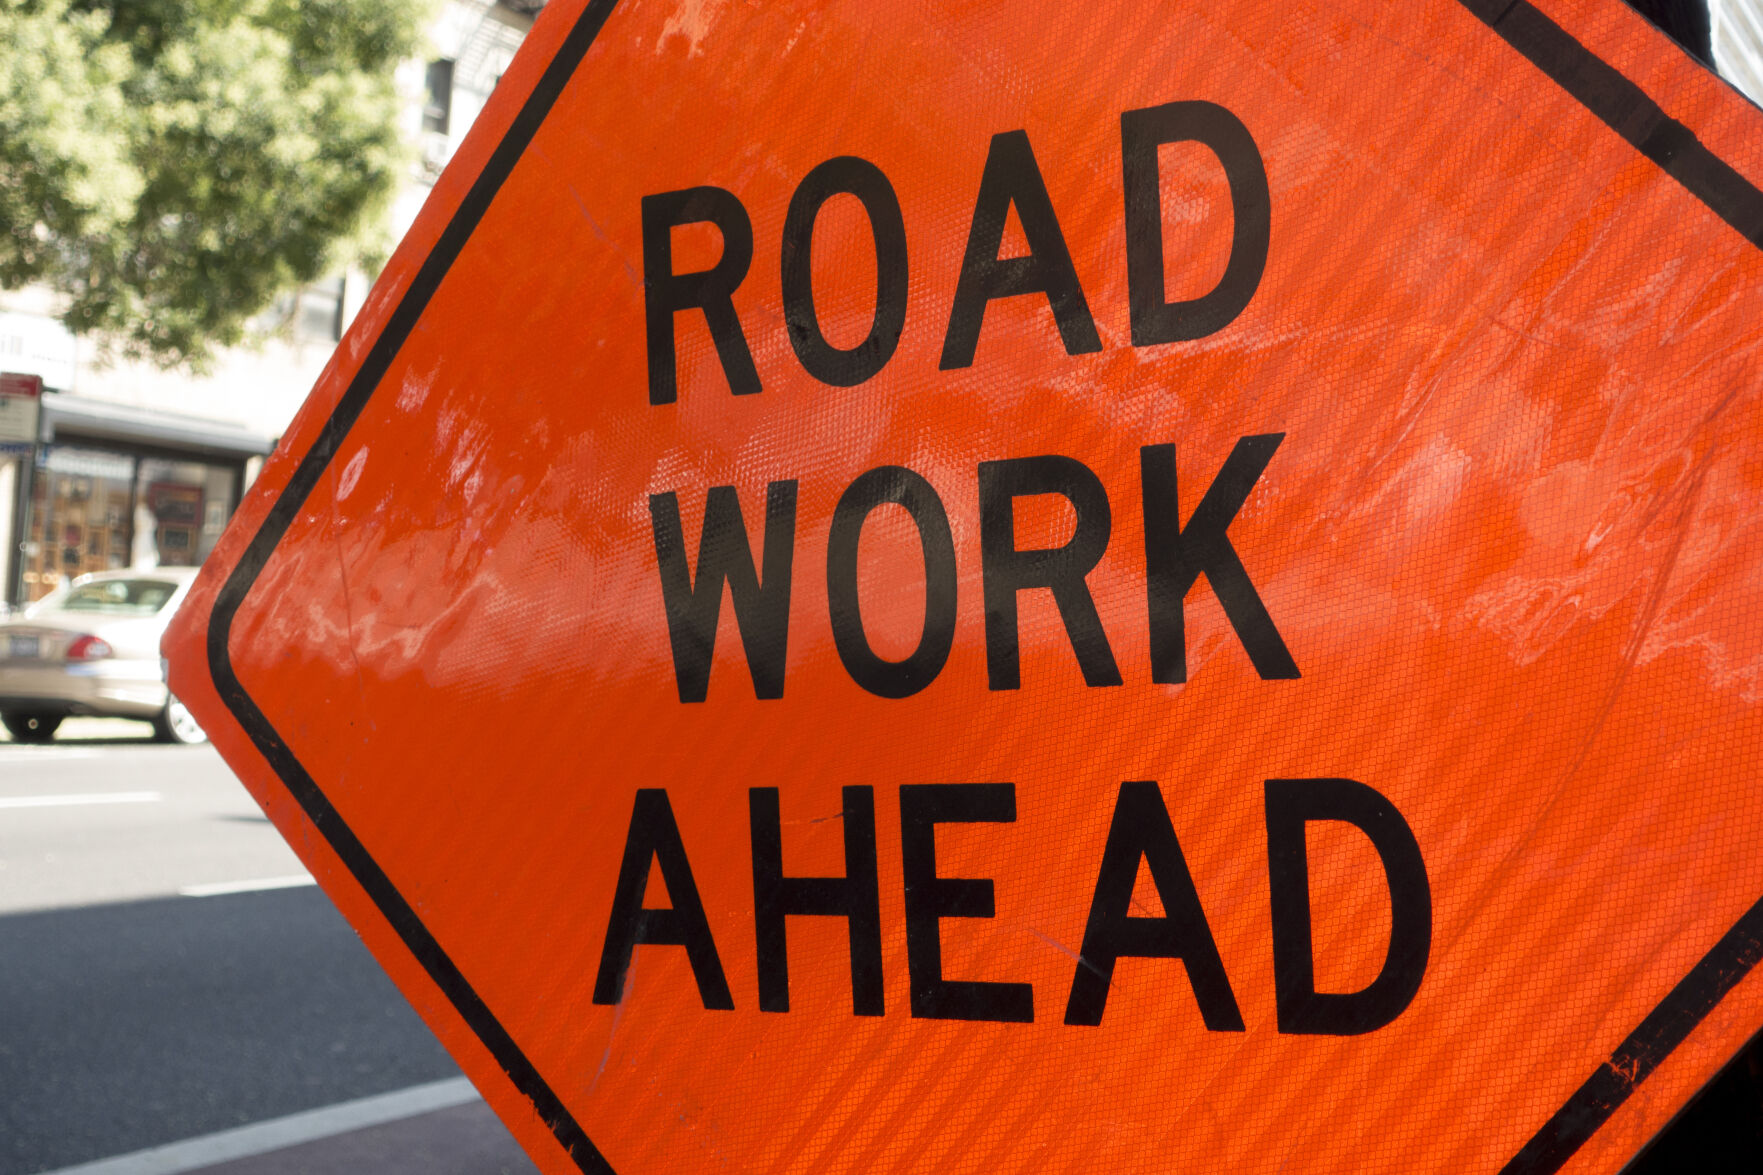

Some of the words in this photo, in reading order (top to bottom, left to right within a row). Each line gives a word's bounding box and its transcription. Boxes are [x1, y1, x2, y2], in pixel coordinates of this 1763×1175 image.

[641, 100, 1271, 406] ROAD
[648, 432, 1302, 705] WORK
[592, 777, 1433, 1037] AHEAD
